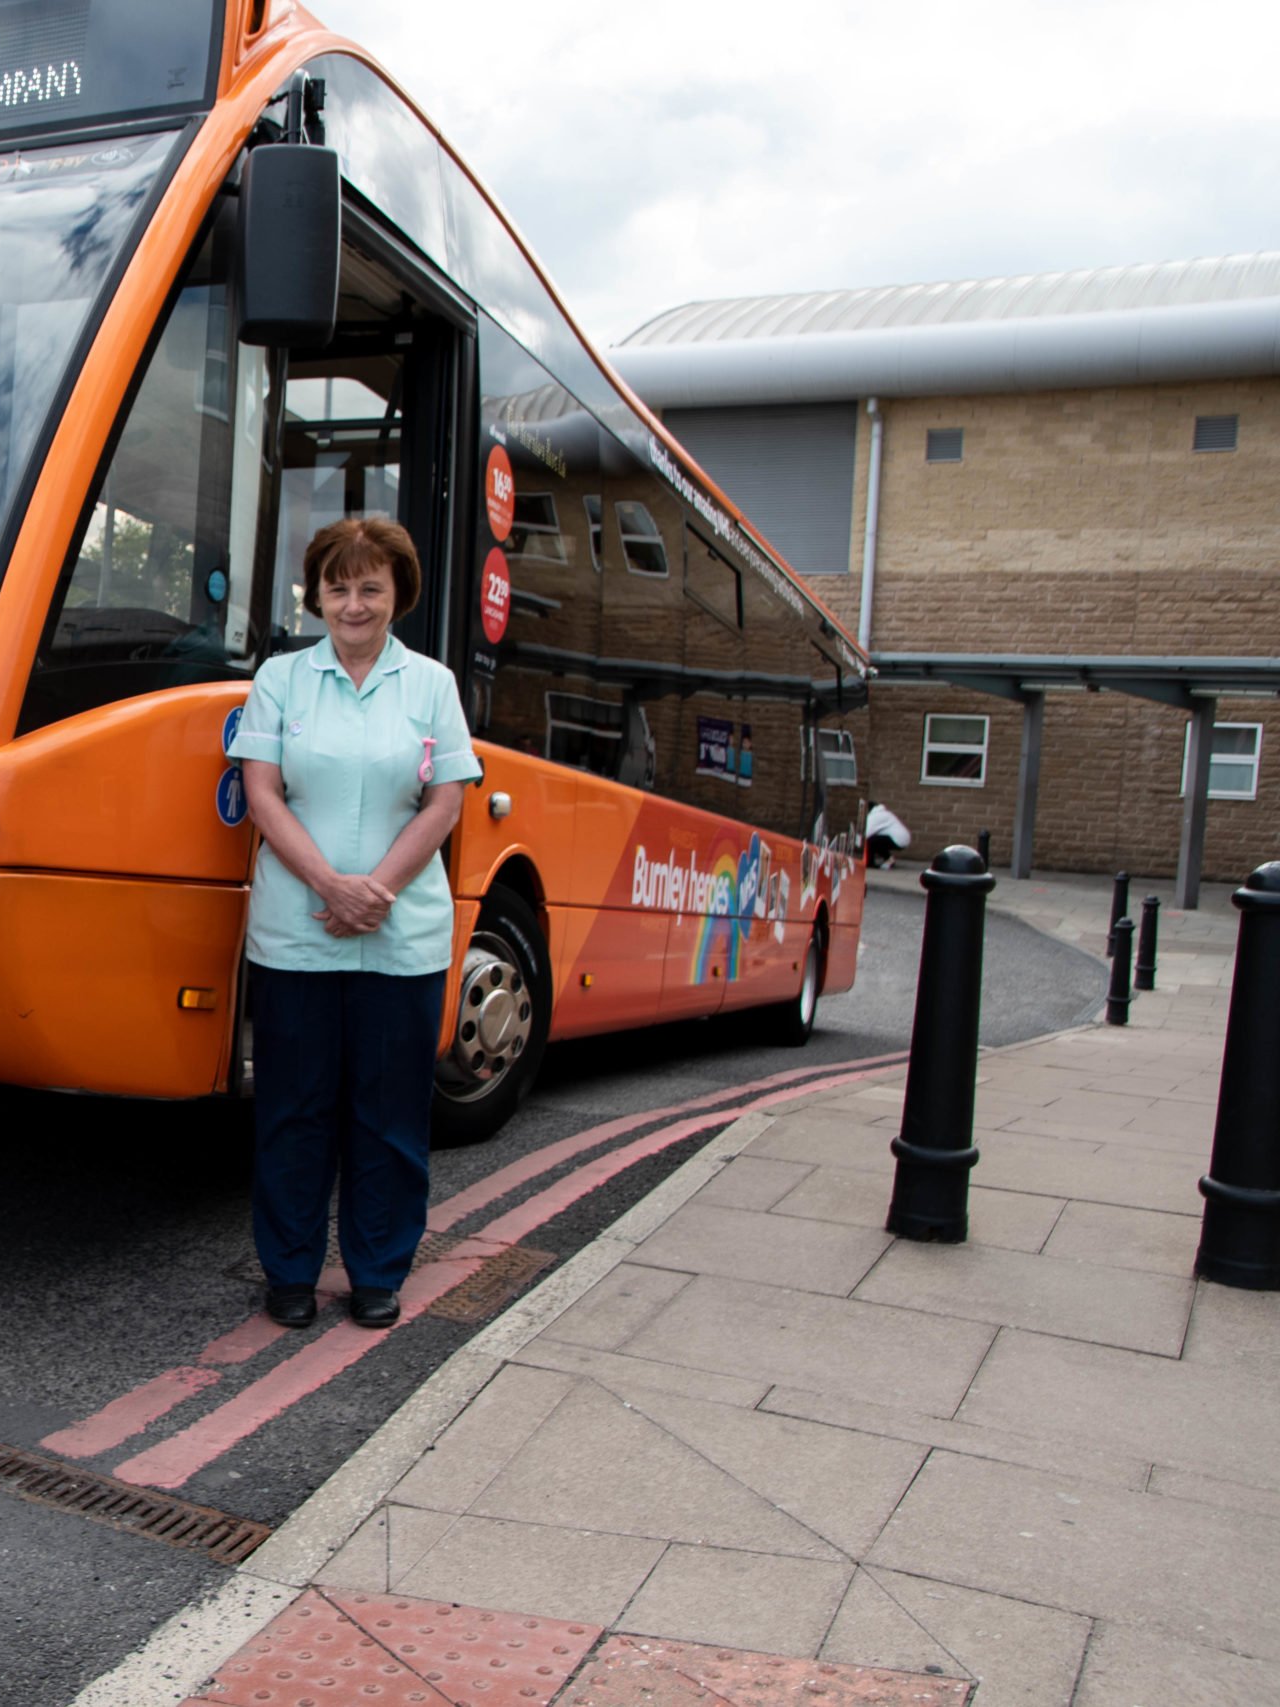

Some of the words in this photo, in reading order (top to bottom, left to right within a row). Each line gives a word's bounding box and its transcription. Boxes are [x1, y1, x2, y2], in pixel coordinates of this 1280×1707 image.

[649, 433, 675, 485] thanks
[682, 477, 694, 505] our
[693, 488, 719, 536] amazing
[632, 845, 688, 927] Burnley
[688, 849, 730, 915] heroes
[740, 858, 758, 910] NHS
